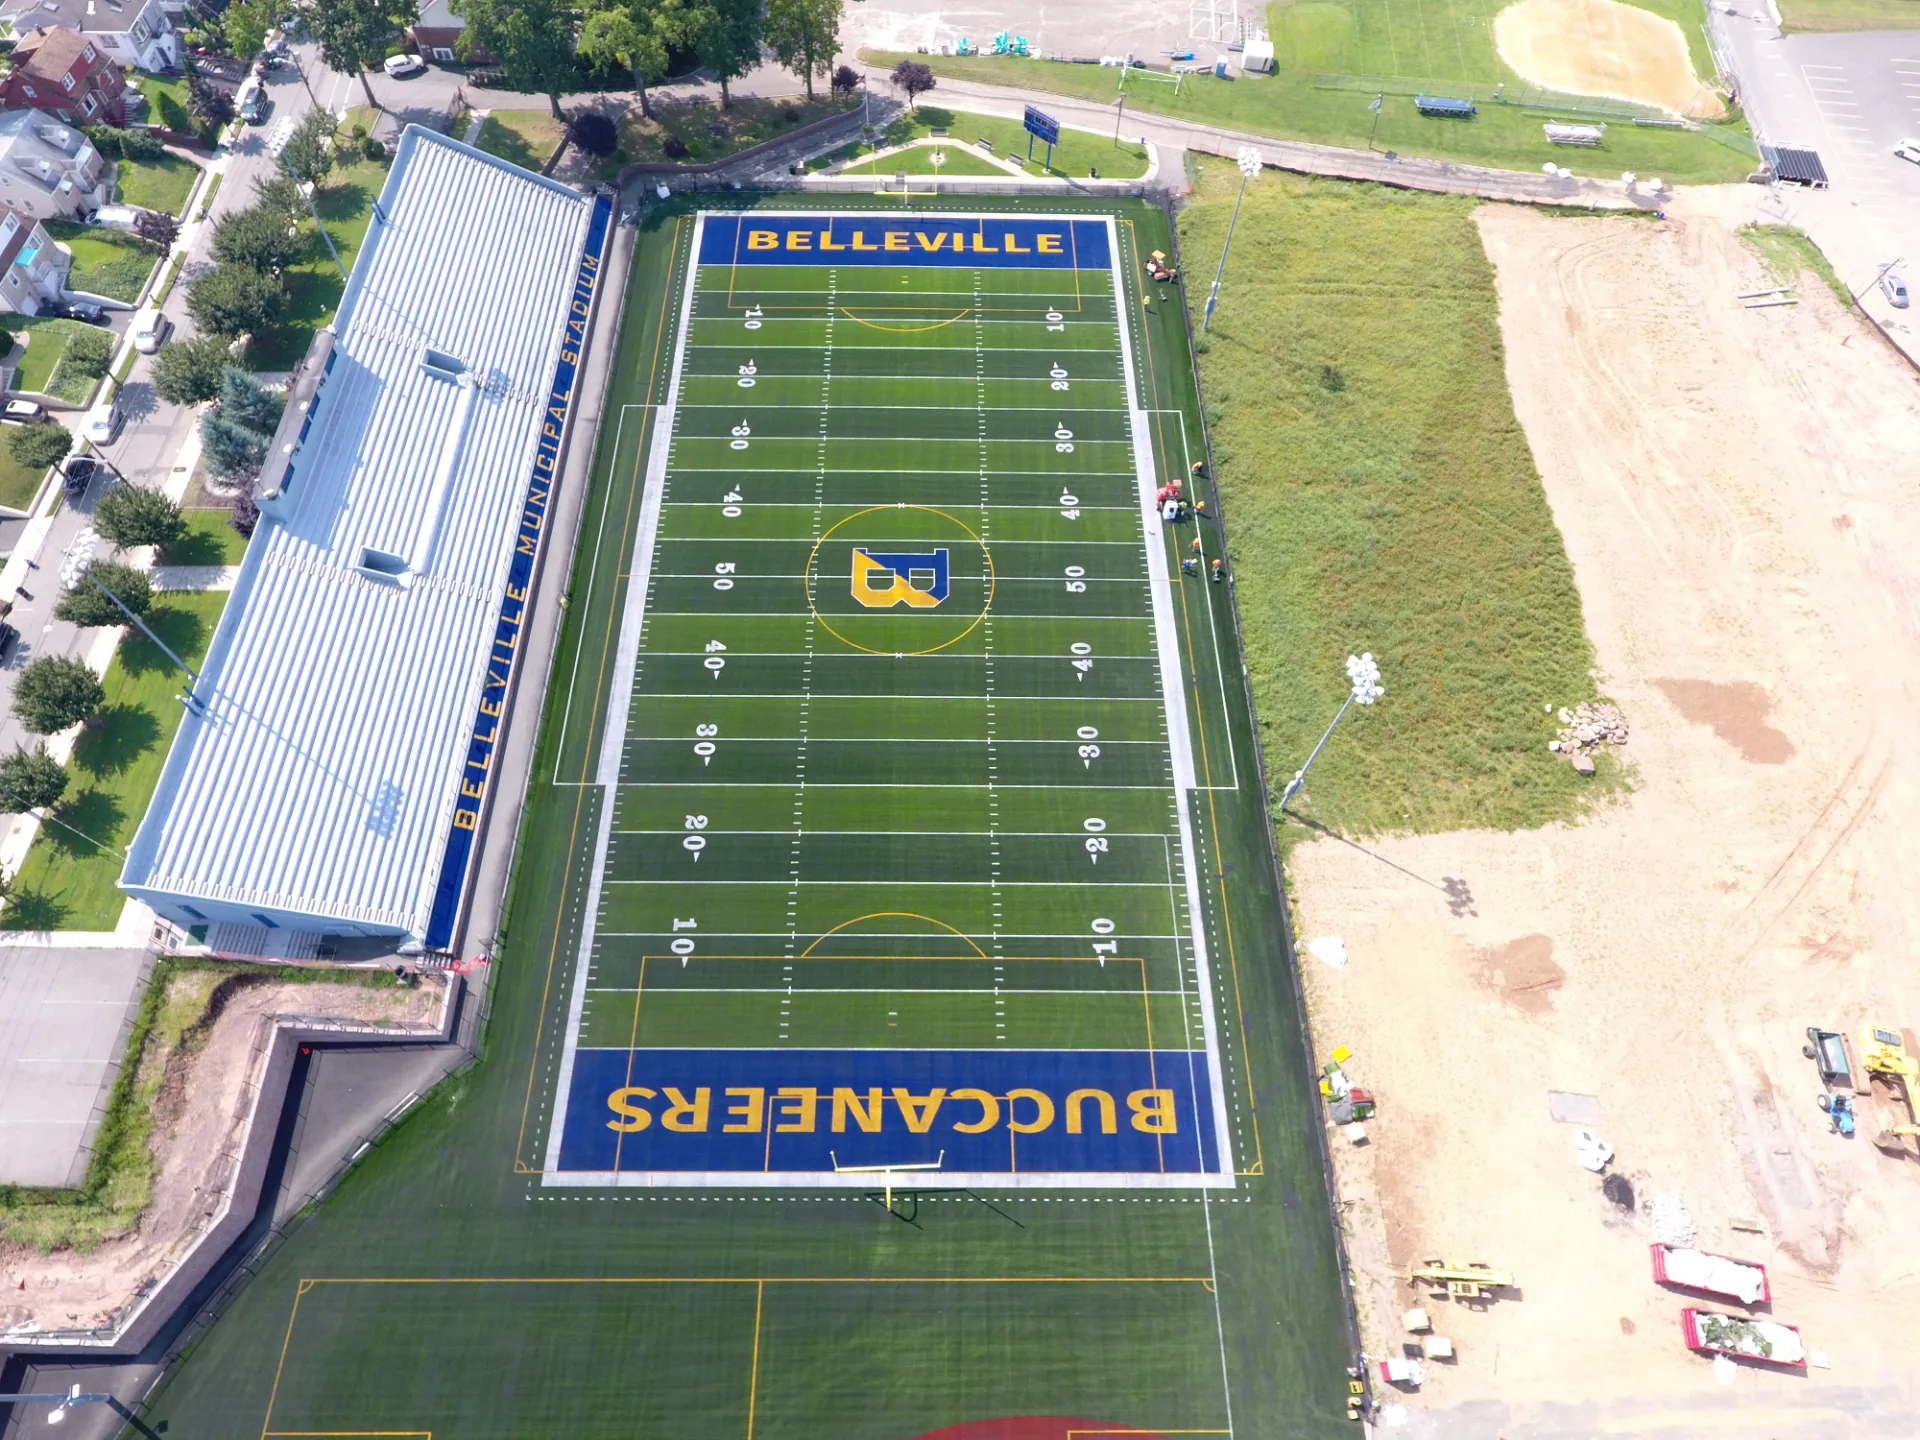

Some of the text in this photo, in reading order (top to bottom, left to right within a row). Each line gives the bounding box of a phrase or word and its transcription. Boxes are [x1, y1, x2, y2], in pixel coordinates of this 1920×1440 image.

[747, 230, 1063, 254] BELLEVILLE
[744, 308, 763, 330] 10
[1046, 310, 1064, 332] 10
[737, 364, 757, 388] 20
[1051, 367, 1069, 391] 20
[730, 425, 751, 450] 30
[722, 491, 744, 518] 40
[1060, 494, 1080, 520] 40
[454, 253, 601, 832] BELLEVILLE MUNICIPAL STADIUM
[713, 562, 736, 591] 50
[850, 546, 950, 608] B
[1065, 565, 1087, 593] 50
[704, 639, 727, 670] 40
[1070, 641, 1092, 672] 40
[694, 723, 719, 756] 30
[1077, 725, 1101, 759] 30
[682, 814, 709, 851] 20
[1083, 817, 1109, 853] 20
[671, 917, 698, 955] 10
[1091, 917, 1118, 955] 10
[605, 1084, 1178, 1136] BUCCANEERS
